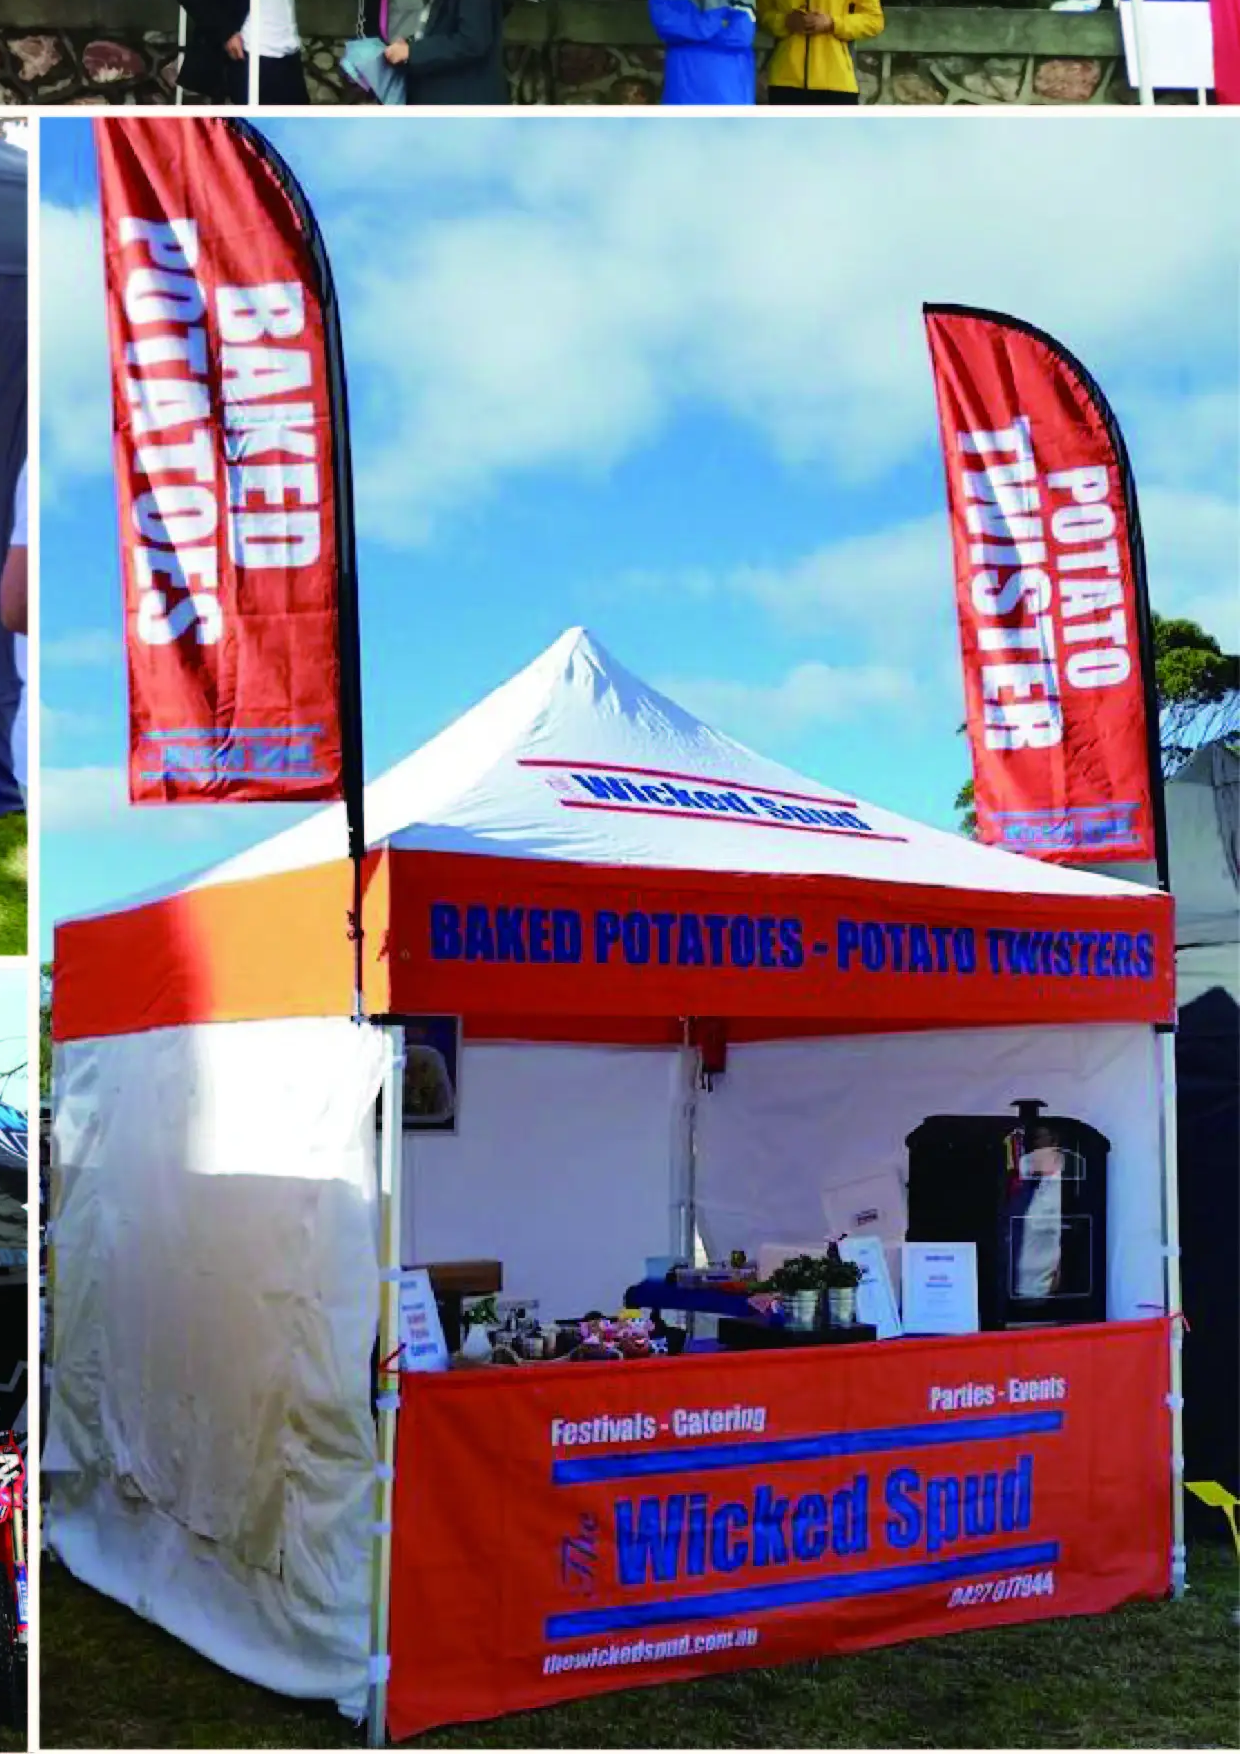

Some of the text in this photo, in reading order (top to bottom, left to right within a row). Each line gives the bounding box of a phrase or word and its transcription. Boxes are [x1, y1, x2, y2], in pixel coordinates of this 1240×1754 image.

[119, 215, 223, 646] POTATOES
[214, 281, 321, 569] BAKED
[1048, 464, 1131, 690] POTATO
[572, 773, 873, 831] Wicked Spud
[430, 902, 582, 964] BAKED
[595, 909, 804, 969] POTATOES
[836, 920, 976, 976] POTATO
[985, 928, 1154, 980] TWISTERS
[550, 1414, 657, 1446] Festivals
[673, 1404, 767, 1439] Catering
[929, 1381, 995, 1411] Parties
[1008, 1376, 1066, 1404] Events
[613, 1473, 872, 1586] Wicked
[883, 1453, 1034, 1554] Spud
[543, 1627, 758, 1675] thewickedspud.com.au
